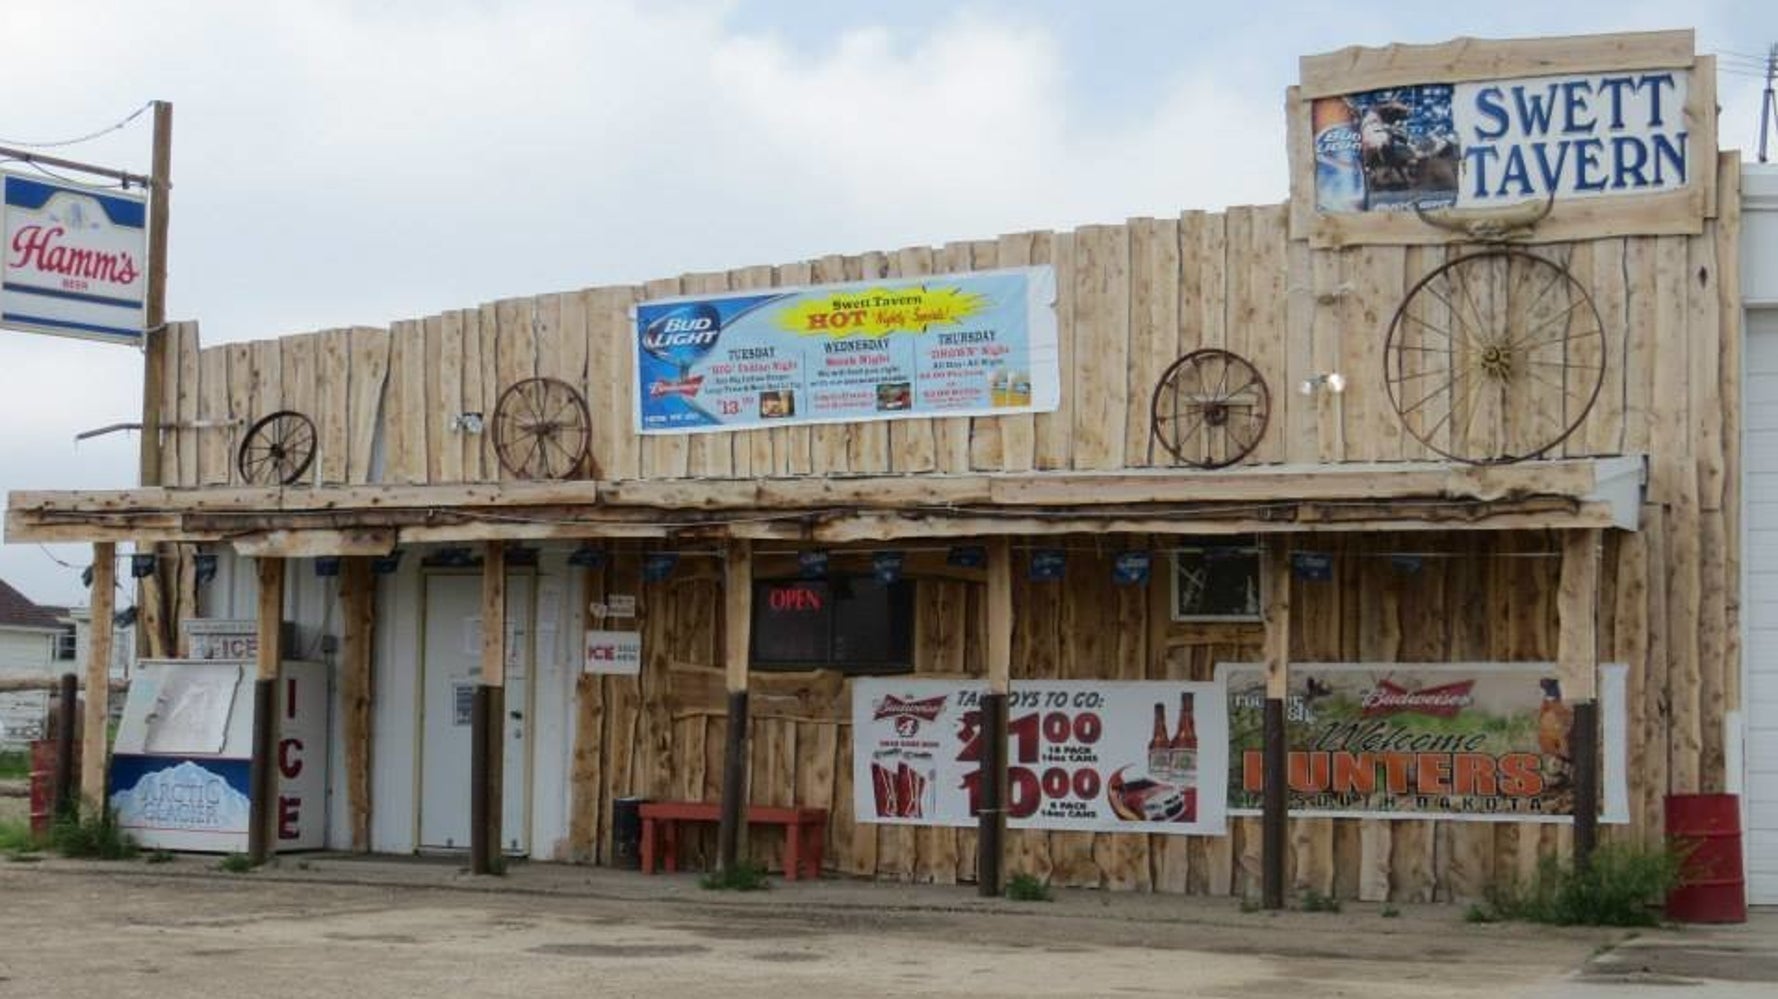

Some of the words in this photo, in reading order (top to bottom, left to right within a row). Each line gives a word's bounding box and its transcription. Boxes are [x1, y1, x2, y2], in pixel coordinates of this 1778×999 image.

[1474, 72, 1675, 140] SWETT
[1465, 131, 1689, 198] TAVERN
[9, 224, 139, 285] Hamm's
[832, 298, 870, 311] Swett
[872, 295, 922, 308] Tavern
[664, 317, 712, 332] BUD
[807, 309, 868, 331] HOT
[651, 329, 718, 347] LIGHT
[824, 338, 889, 354] WEDNESDAY
[938, 330, 995, 346] THURSDAY
[728, 346, 776, 361] TUESDAY
[767, 587, 822, 612] OPEN
[222, 638, 258, 658] ICE
[589, 645, 615, 661] ICE
[957, 690, 1041, 708] TALOYS
[1044, 690, 1069, 708] TO
[1072, 690, 1106, 709] GO:
[1314, 721, 1486, 752] Welcome
[278, 678, 303, 840] ICE
[1415, 795, 1544, 812] DAKOTA
